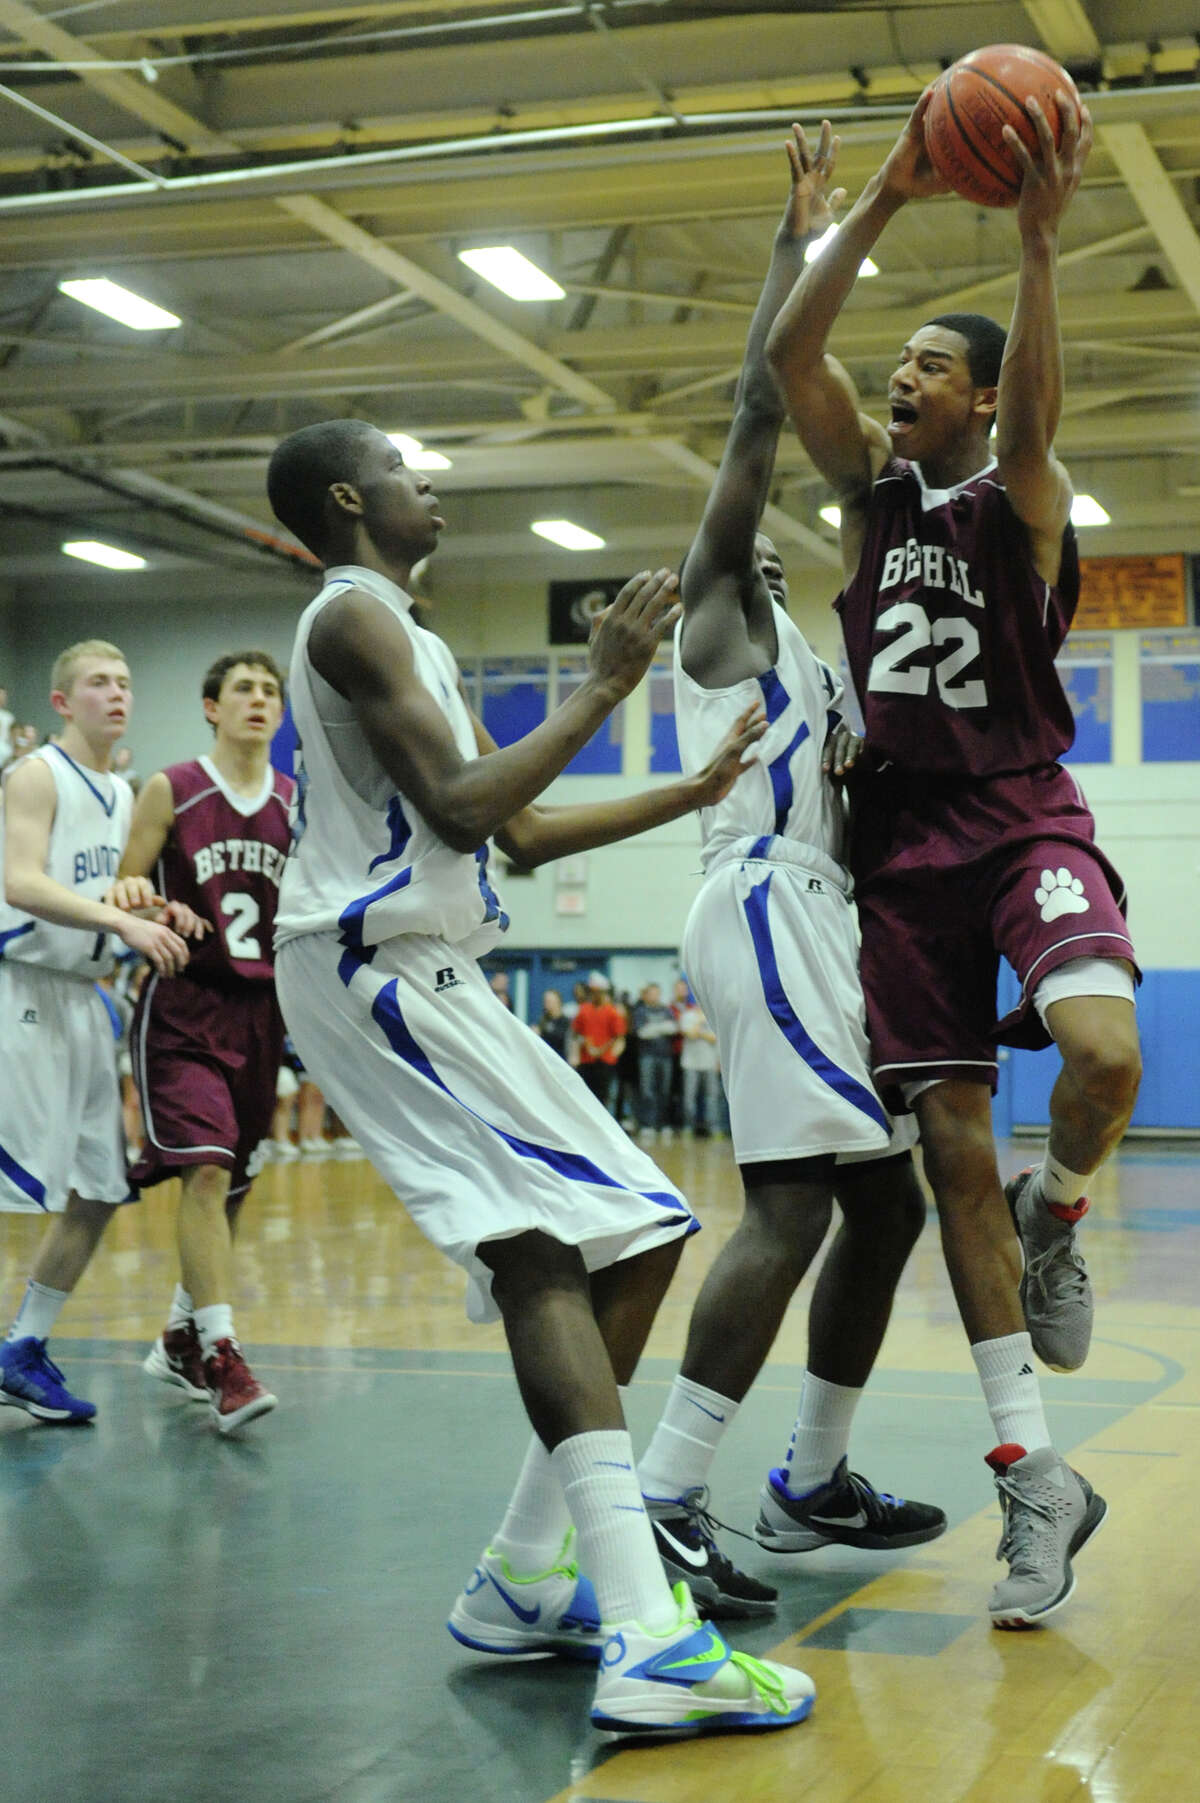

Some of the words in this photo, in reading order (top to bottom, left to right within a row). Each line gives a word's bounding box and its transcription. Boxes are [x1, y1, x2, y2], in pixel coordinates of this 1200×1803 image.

[879, 538, 985, 608] BEHEL
[867, 602, 988, 709] 22
[221, 892, 261, 959] 2
[436, 967, 455, 985] R
